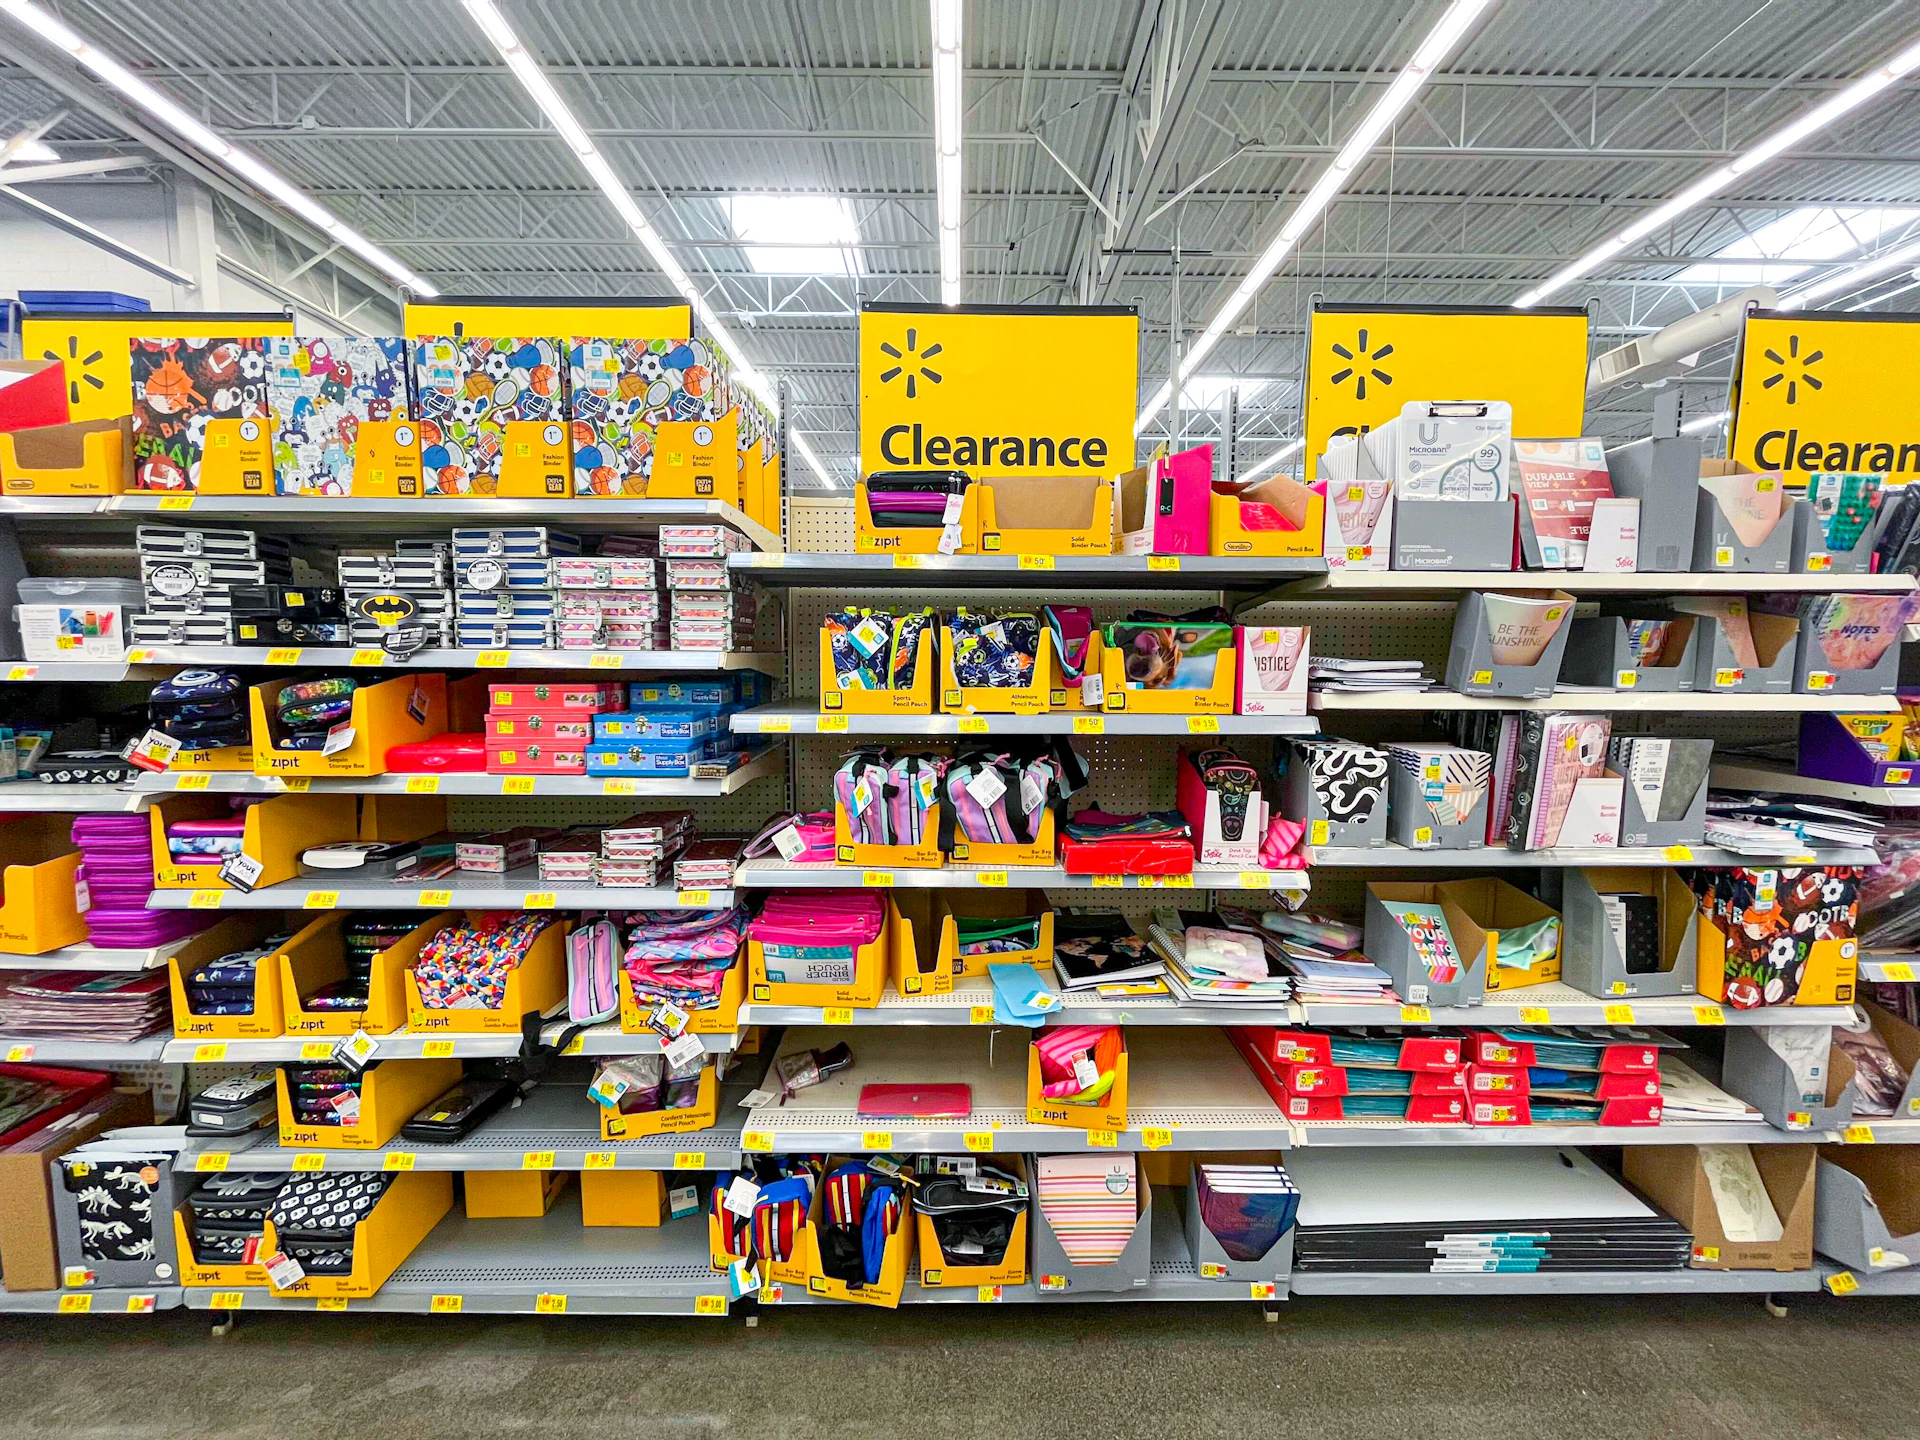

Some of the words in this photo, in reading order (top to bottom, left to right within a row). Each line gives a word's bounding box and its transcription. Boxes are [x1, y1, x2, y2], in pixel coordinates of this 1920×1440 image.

[880, 423, 1108, 467] Clearance
[542, 453, 565, 461] Fashion
[692, 454, 714, 462] Fashion
[1525, 472, 1576, 484] DURABLE
[1527, 480, 1550, 490] VIEW
[873, 535, 901, 549] zipit
[1497, 623, 1514, 634] BE
[1518, 624, 1541, 636] THE
[1841, 624, 1880, 637] NOTES
[1851, 717, 1889, 728] Crayola
[271, 757, 301, 770] zipit
[328, 763, 352, 771] Storage
[352, 763, 365, 771] Box
[656, 758, 672, 768] Supply
[672, 758, 686, 767] Box
[1414, 941, 1437, 953] EAR
[1437, 942, 1452, 953] TO
[1422, 953, 1458, 969] HINE
[805, 969, 850, 980] BINDER
[300, 1019, 326, 1032] zipit
[425, 1016, 450, 1029] zipit
[660, 1114, 684, 1122] Confetti
[683, 1110, 712, 1120] Telescopic
[1042, 1109, 1069, 1121] zipit
[677, 1119, 696, 1127] Pouch
[294, 1132, 318, 1144] zipit
